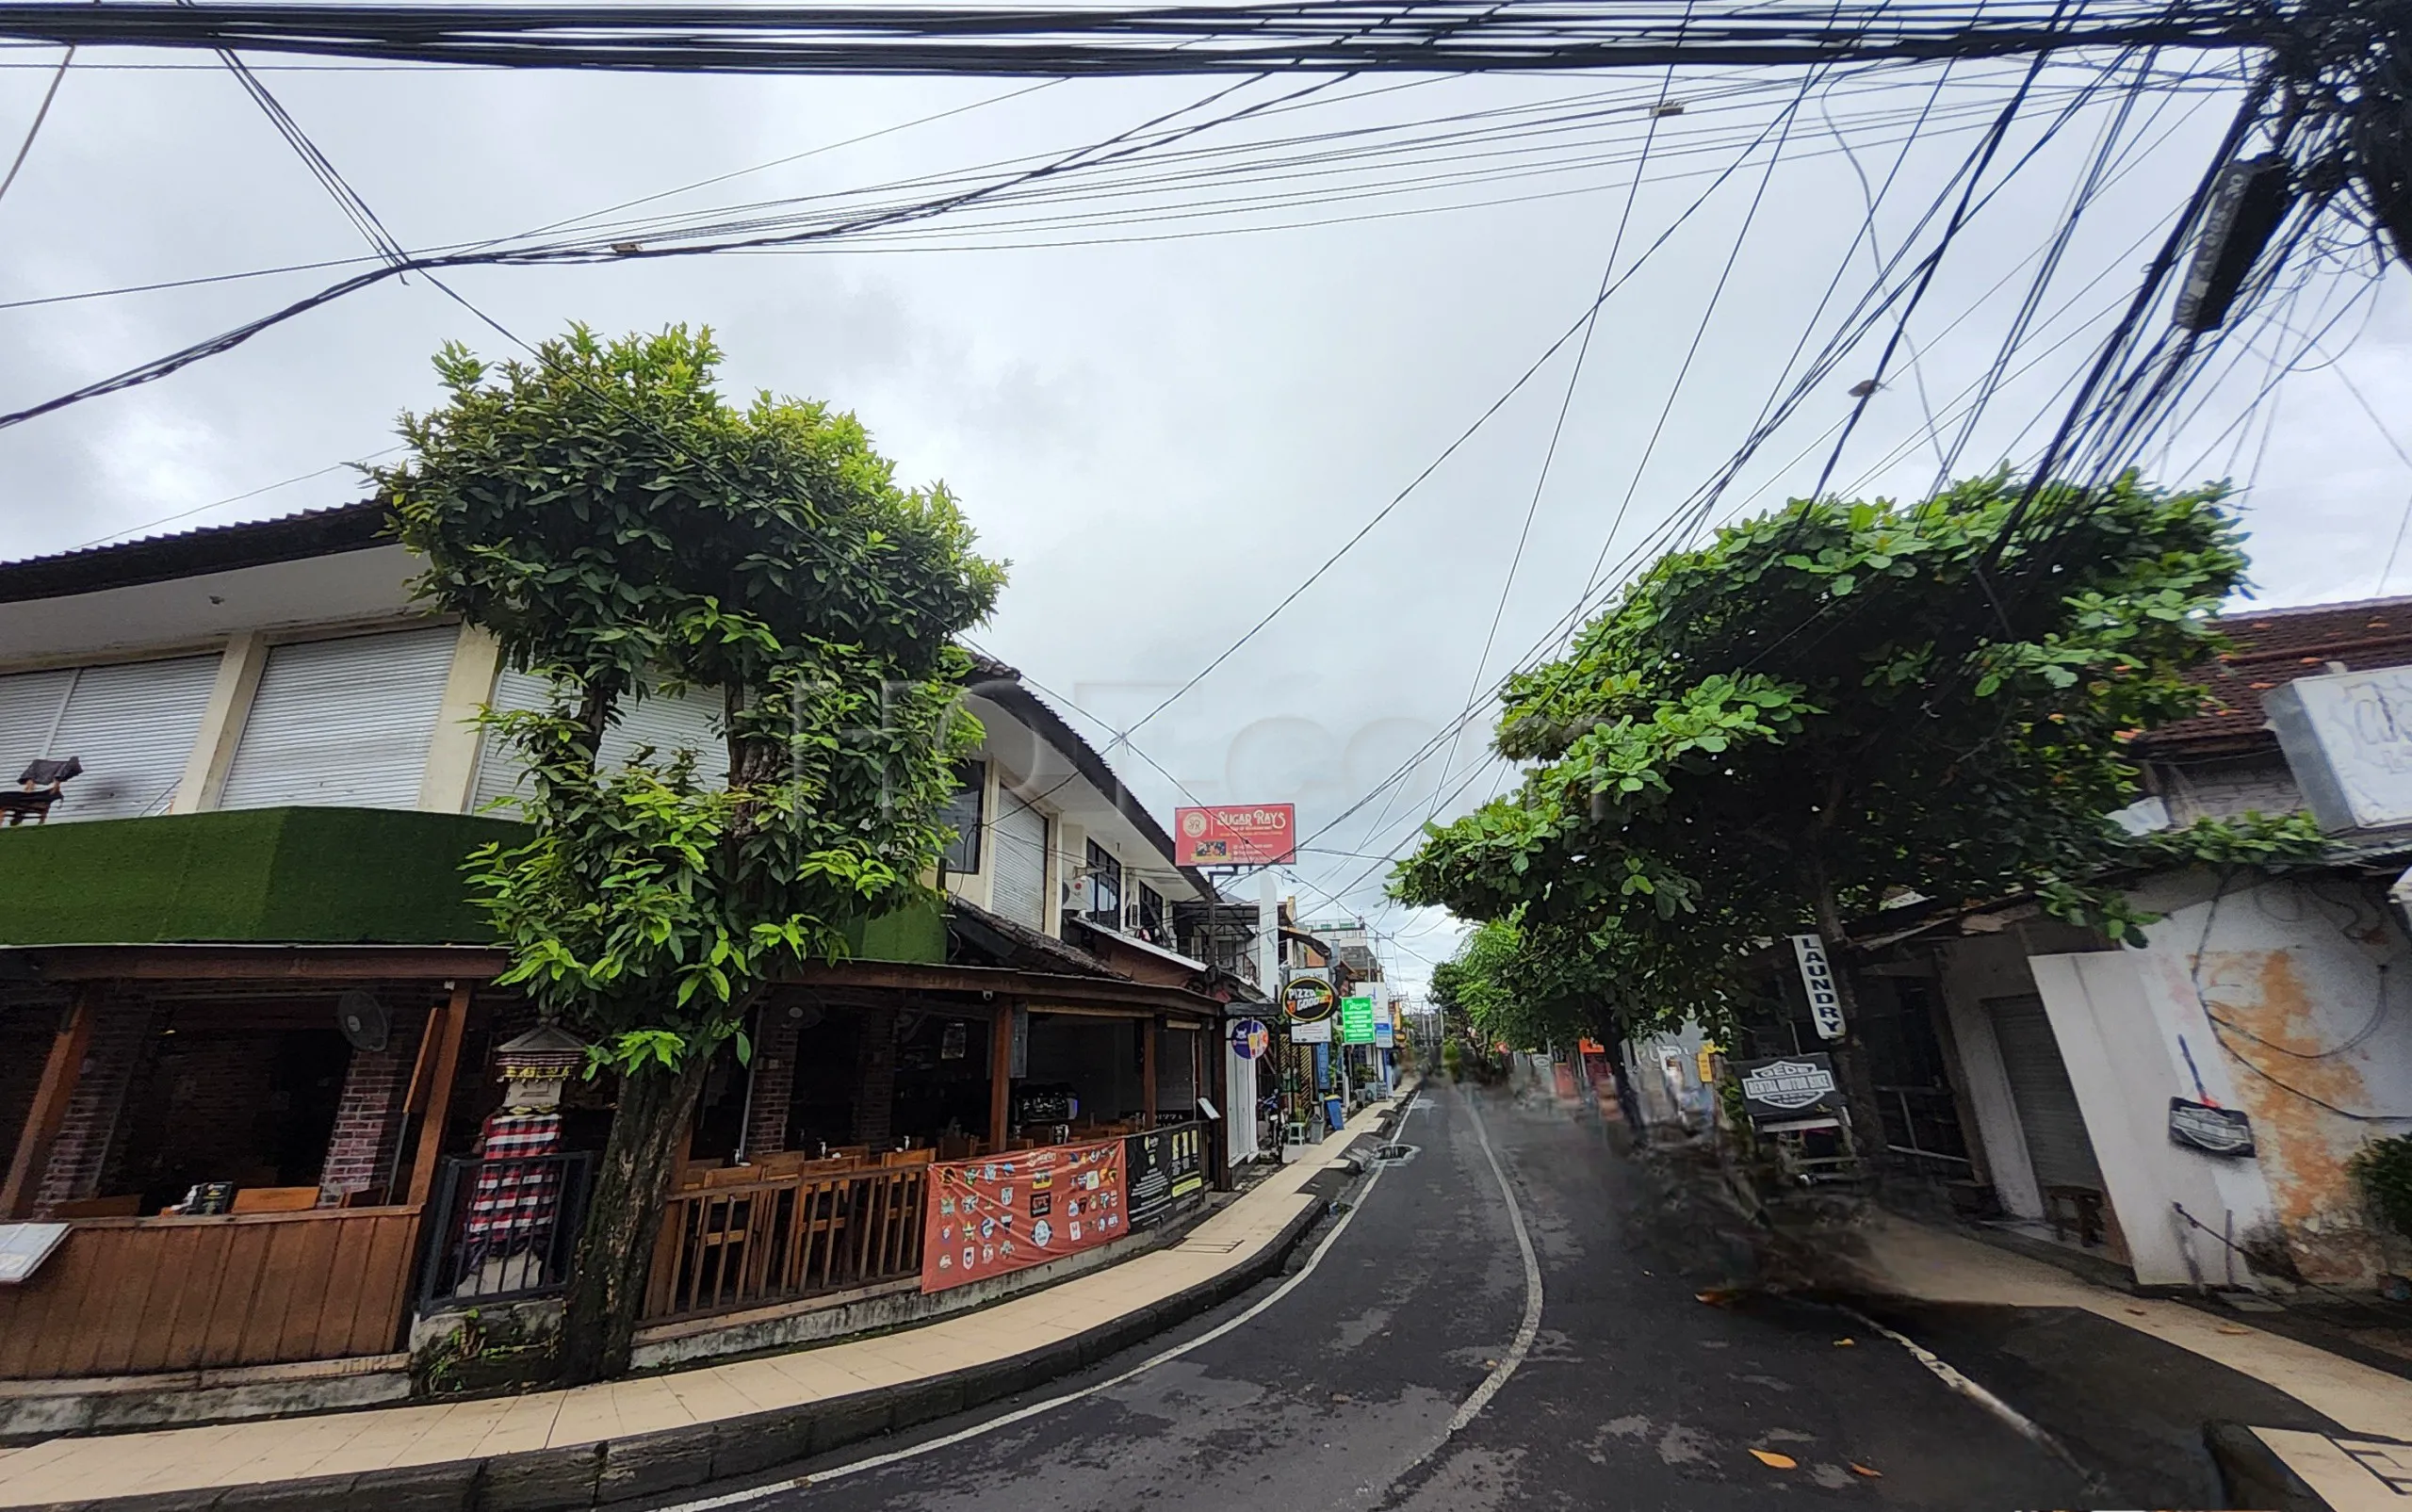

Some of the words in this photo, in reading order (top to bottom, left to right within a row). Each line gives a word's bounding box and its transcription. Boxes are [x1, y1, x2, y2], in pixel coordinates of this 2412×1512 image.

[1217, 811, 1252, 826] SUGAR
[1801, 938, 1841, 1032] LAUNDRY
[1288, 988, 1316, 1000] PIZZA
[1748, 1081, 1779, 1095] RENTAL
[1777, 1077, 1808, 1091] MOTOR
